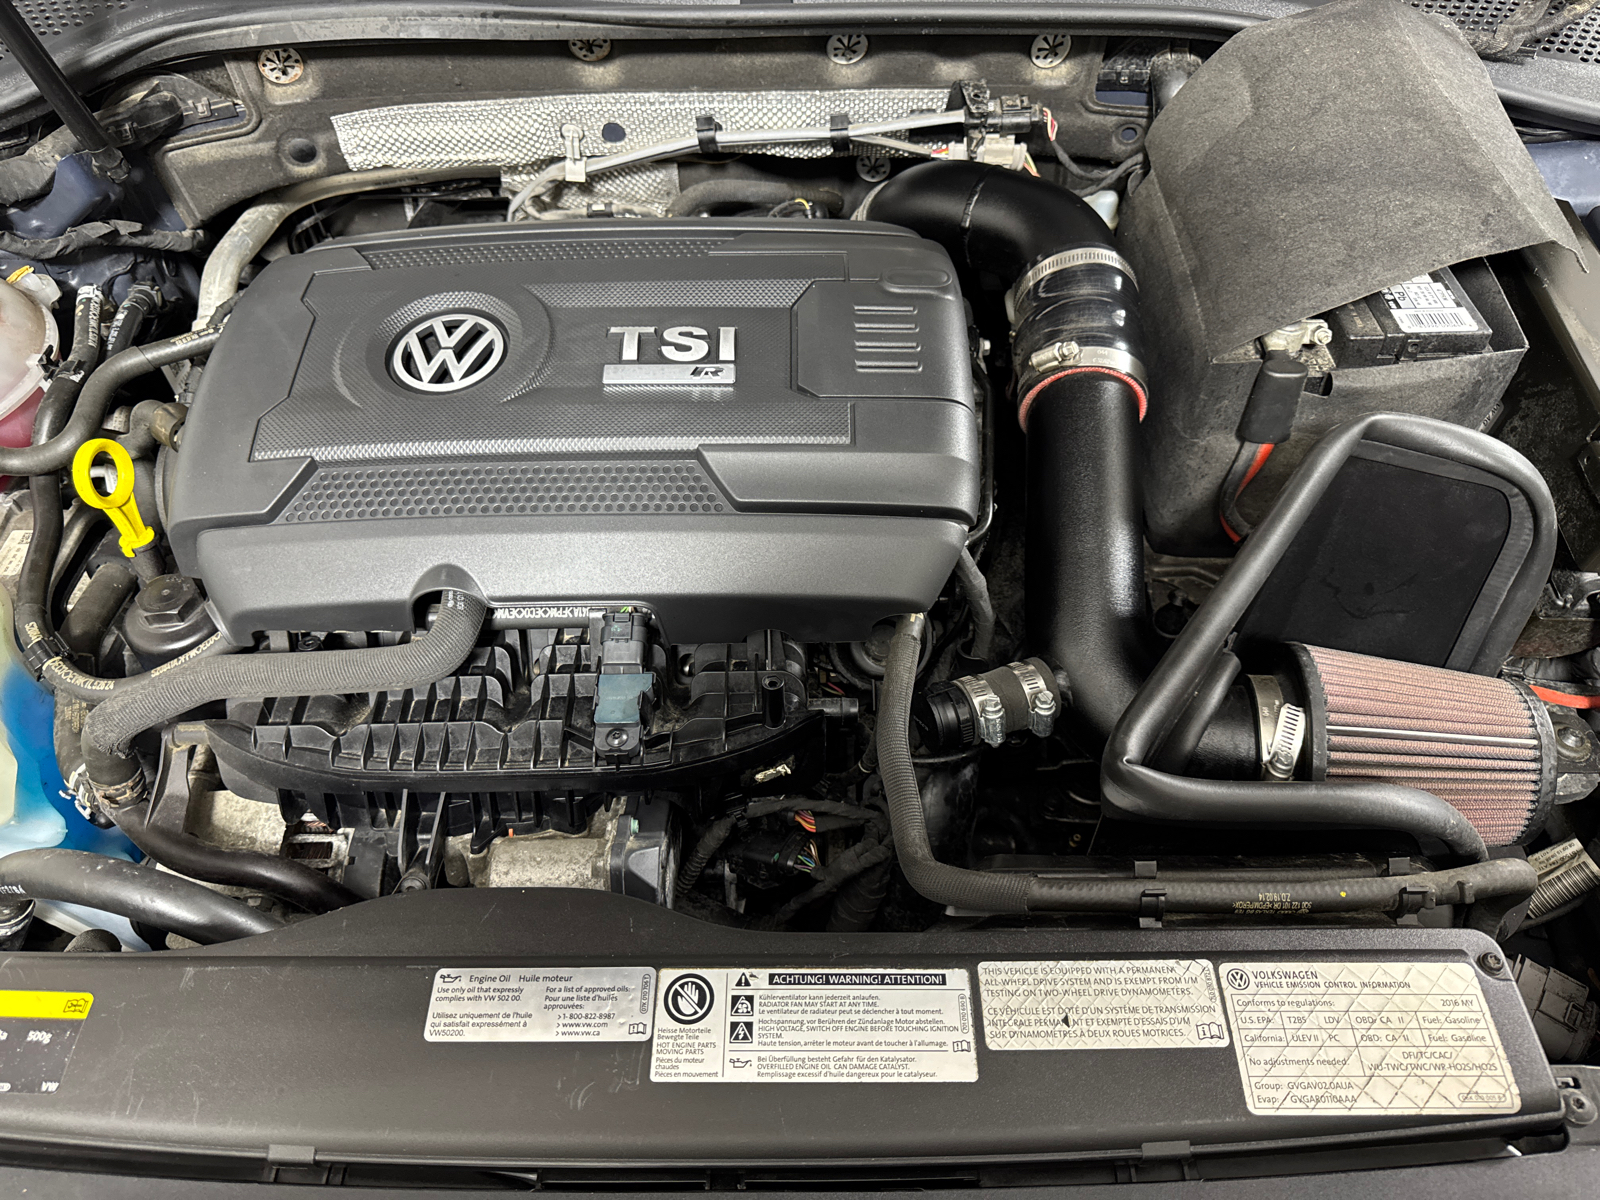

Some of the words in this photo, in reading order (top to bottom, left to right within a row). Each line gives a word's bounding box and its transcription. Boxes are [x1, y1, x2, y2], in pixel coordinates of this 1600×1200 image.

[1394, 290, 1406, 302] Pb
[608, 326, 736, 362] TSI
[1282, 901, 1290, 910] 101
[1292, 901, 1301, 910] 122
[983, 967, 1002, 975] THIS
[1003, 967, 1039, 975] VEHICLE
[1040, 967, 1048, 975] IS
[1050, 967, 1092, 975] EQUIPPED
[1093, 966, 1117, 974] WITH
[1118, 966, 1125, 974] A
[1251, 970, 1318, 980] VOLKSWAGEN
[469, 974, 498, 984] Engine
[498, 974, 511, 982] Oil
[518, 974, 540, 982] Huile
[542, 974, 573, 982] moteur
[773, 975, 826, 984] ACHTUNG!
[828, 975, 881, 984] WARNING!
[884, 975, 943, 984] ATTENTION!
[1033, 978, 1058, 986] DRIVE
[1060, 978, 1091, 986] SYSTEM
[1124, 977, 1156, 985] EXEMPT
[1158, 976, 1182, 984] FROM
[1184, 976, 1198, 984] I/M
[1254, 981, 1284, 989] VEHICLE
[1286, 981, 1321, 989] EMISSION
[1323, 981, 1358, 989] CONTROL
[1360, 981, 1410, 989] INFORMATION
[451, 987, 466, 995] only
[492, 987, 524, 995] expressly
[584, 986, 616, 994] approved
[986, 989, 1021, 997] TESTING
[1022, 989, 1037, 997] ON
[1038, 989, 1092, 997] TWO-WHEEL
[1093, 988, 1119, 996] DRIVE
[1121, 988, 1194, 996] DYNAMOMETERS.
[435, 995, 466, 1003] complies
[1287, 999, 1335, 1008] regulations:
[1441, 999, 1460, 1007] 2016
[1461, 999, 1474, 1007] MY
[543, 1003, 585, 1011] approuvées:
[988, 1007, 999, 1015] CE
[1041, 1007, 1055, 1015] EST
[1081, 1006, 1104, 1014] D'UN
[1105, 1004, 1140, 1014] SYSTÈME
[1142, 1006, 1154, 1014] DE
[1154, 1005, 1216, 1014] TRANSMISSION
[459, 1012, 500, 1020] uniquement
[1240, 1016, 1256, 1024] U.S.
[1287, 1016, 1307, 1024] T2B5
[1324, 1016, 1341, 1024] LDV
[1380, 1016, 1392, 1024] CA
[1398, 1016, 1404, 1024] II
[1422, 1016, 1442, 1024] Fuel:
[1445, 1016, 1481, 1024] Gasoline
[26, 1030, 52, 1044] 500g
[657, 1034, 684, 1042] Bewegte
[1244, 1034, 1285, 1042] California:
[1292, 1034, 1312, 1042] ULEV
[1313, 1034, 1319, 1042] II
[1328, 1034, 1340, 1042] PC
[1360, 1034, 1382, 1042] OBD:
[1385, 1034, 1397, 1042] CA
[1402, 1034, 1410, 1042] II
[1428, 1034, 1448, 1042] Fuel:
[1450, 1034, 1486, 1042] Gasoline
[1249, 1058, 1262, 1066] No
[1263, 1058, 1315, 1068] adjustments
[1316, 1058, 1350, 1066] needed.
[40, 1081, 60, 1092] VW
[1254, 1082, 1283, 1092] Group:
[1257, 1095, 1280, 1105] Evap:
